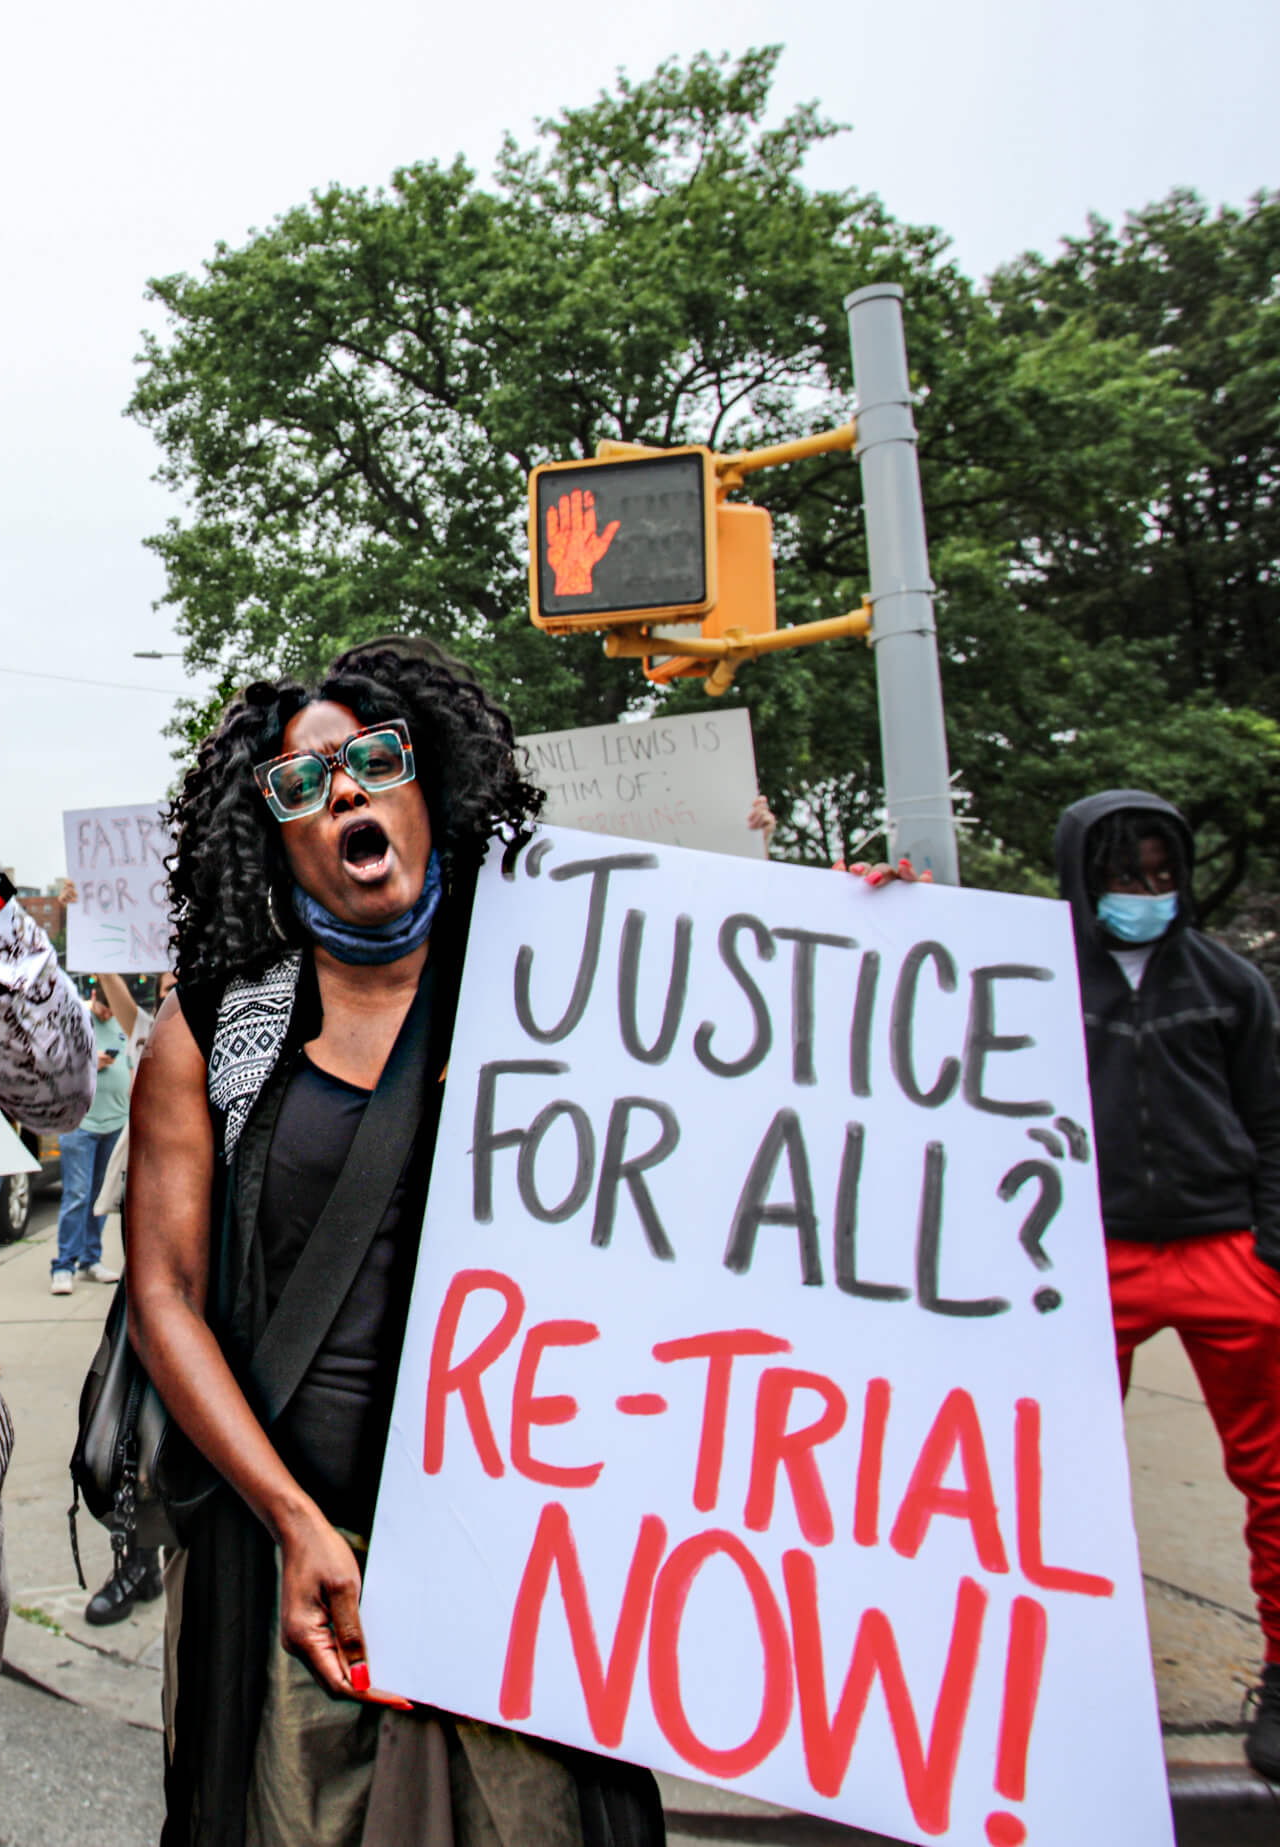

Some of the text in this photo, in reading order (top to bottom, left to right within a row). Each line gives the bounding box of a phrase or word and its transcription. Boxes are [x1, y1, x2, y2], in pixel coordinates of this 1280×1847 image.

[602, 729, 676, 766] LEWIS
[690, 721, 721, 752] IS
[80, 877, 138, 916] FOR
[467, 1059, 678, 1263] FOR
[422, 1268, 1116, 1598] RE-TRIAL
[499, 1501, 1048, 1847] NOW!
